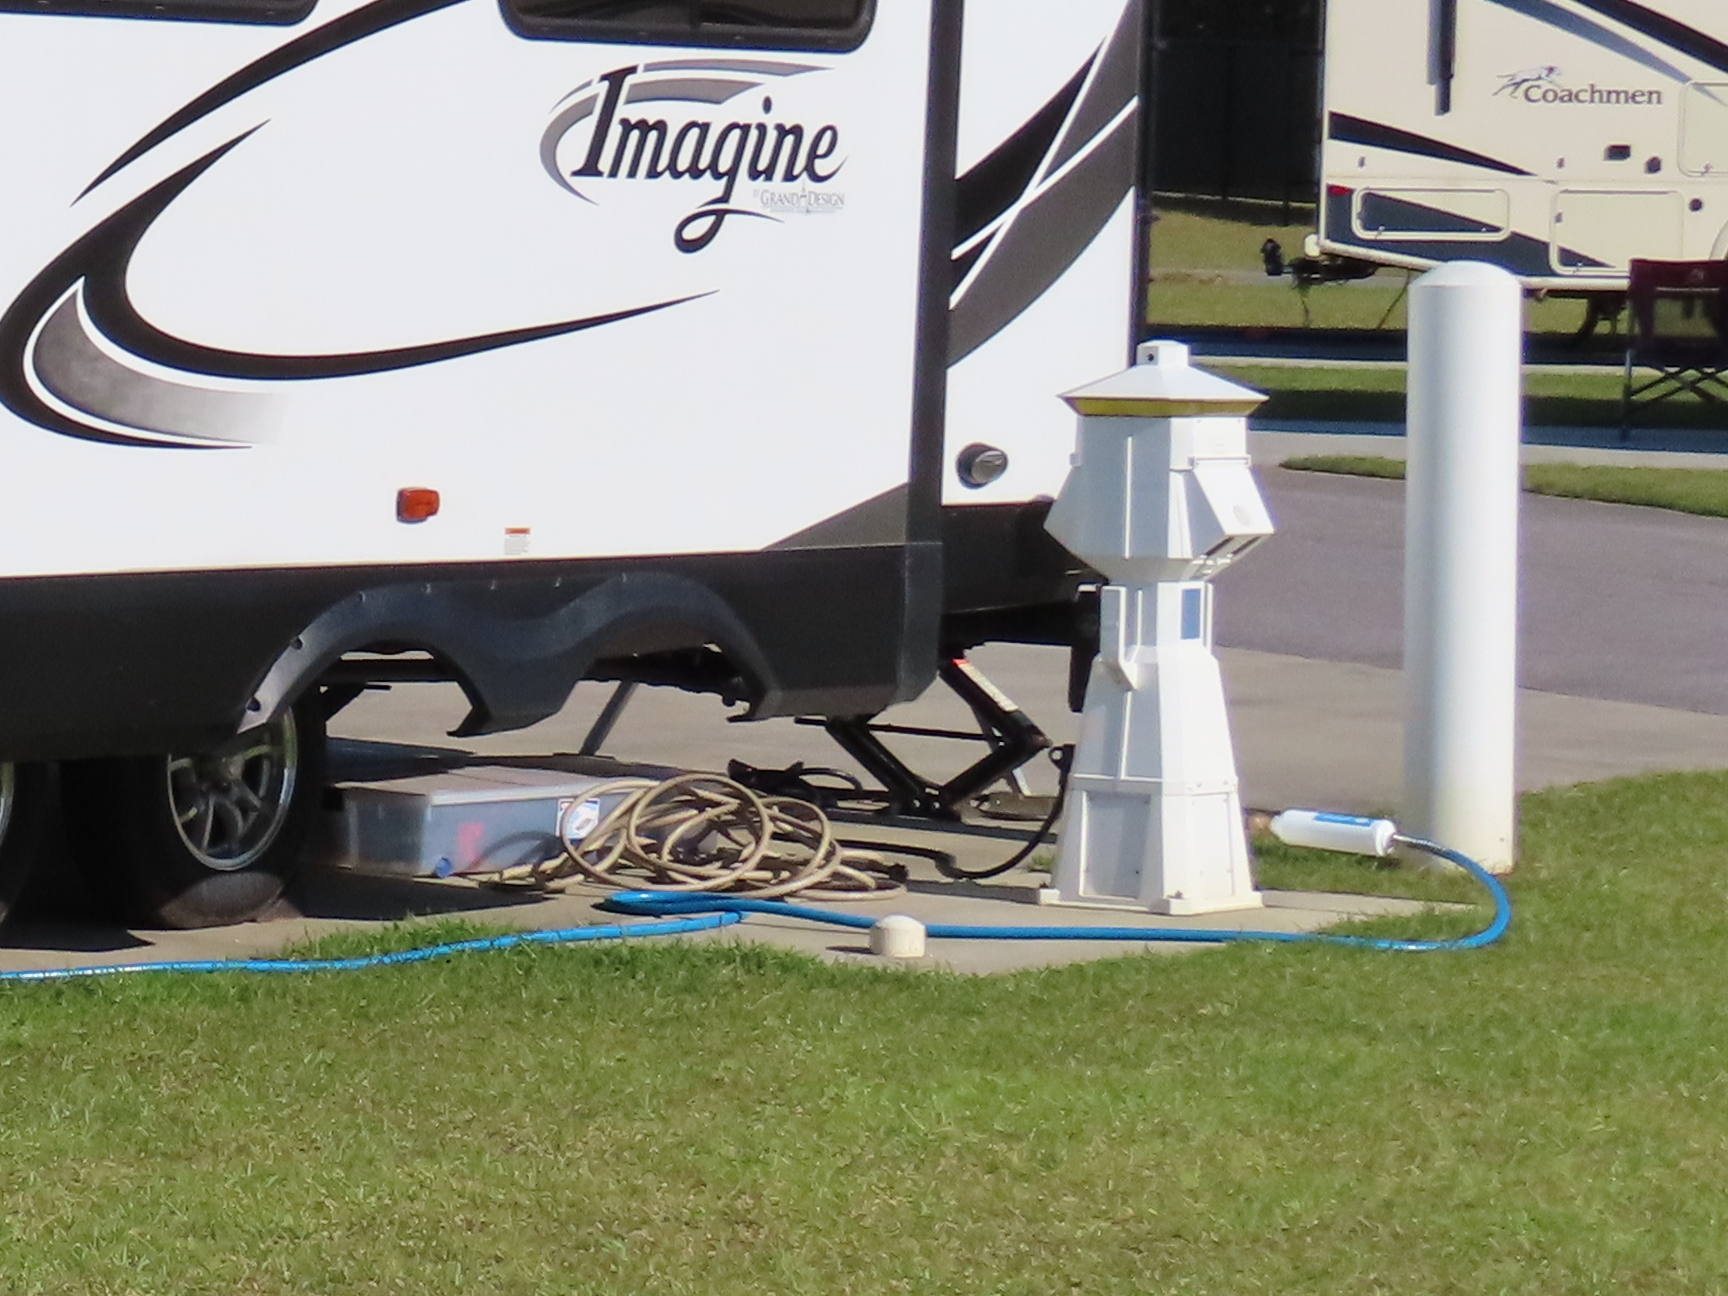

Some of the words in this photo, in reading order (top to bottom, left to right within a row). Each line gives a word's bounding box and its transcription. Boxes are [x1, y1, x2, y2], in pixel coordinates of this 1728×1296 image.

[1524, 84, 1663, 105] Coachmen
[570, 64, 848, 254] Imagine
[760, 189, 799, 207] GRAND
[807, 190, 845, 207] DESIGN
